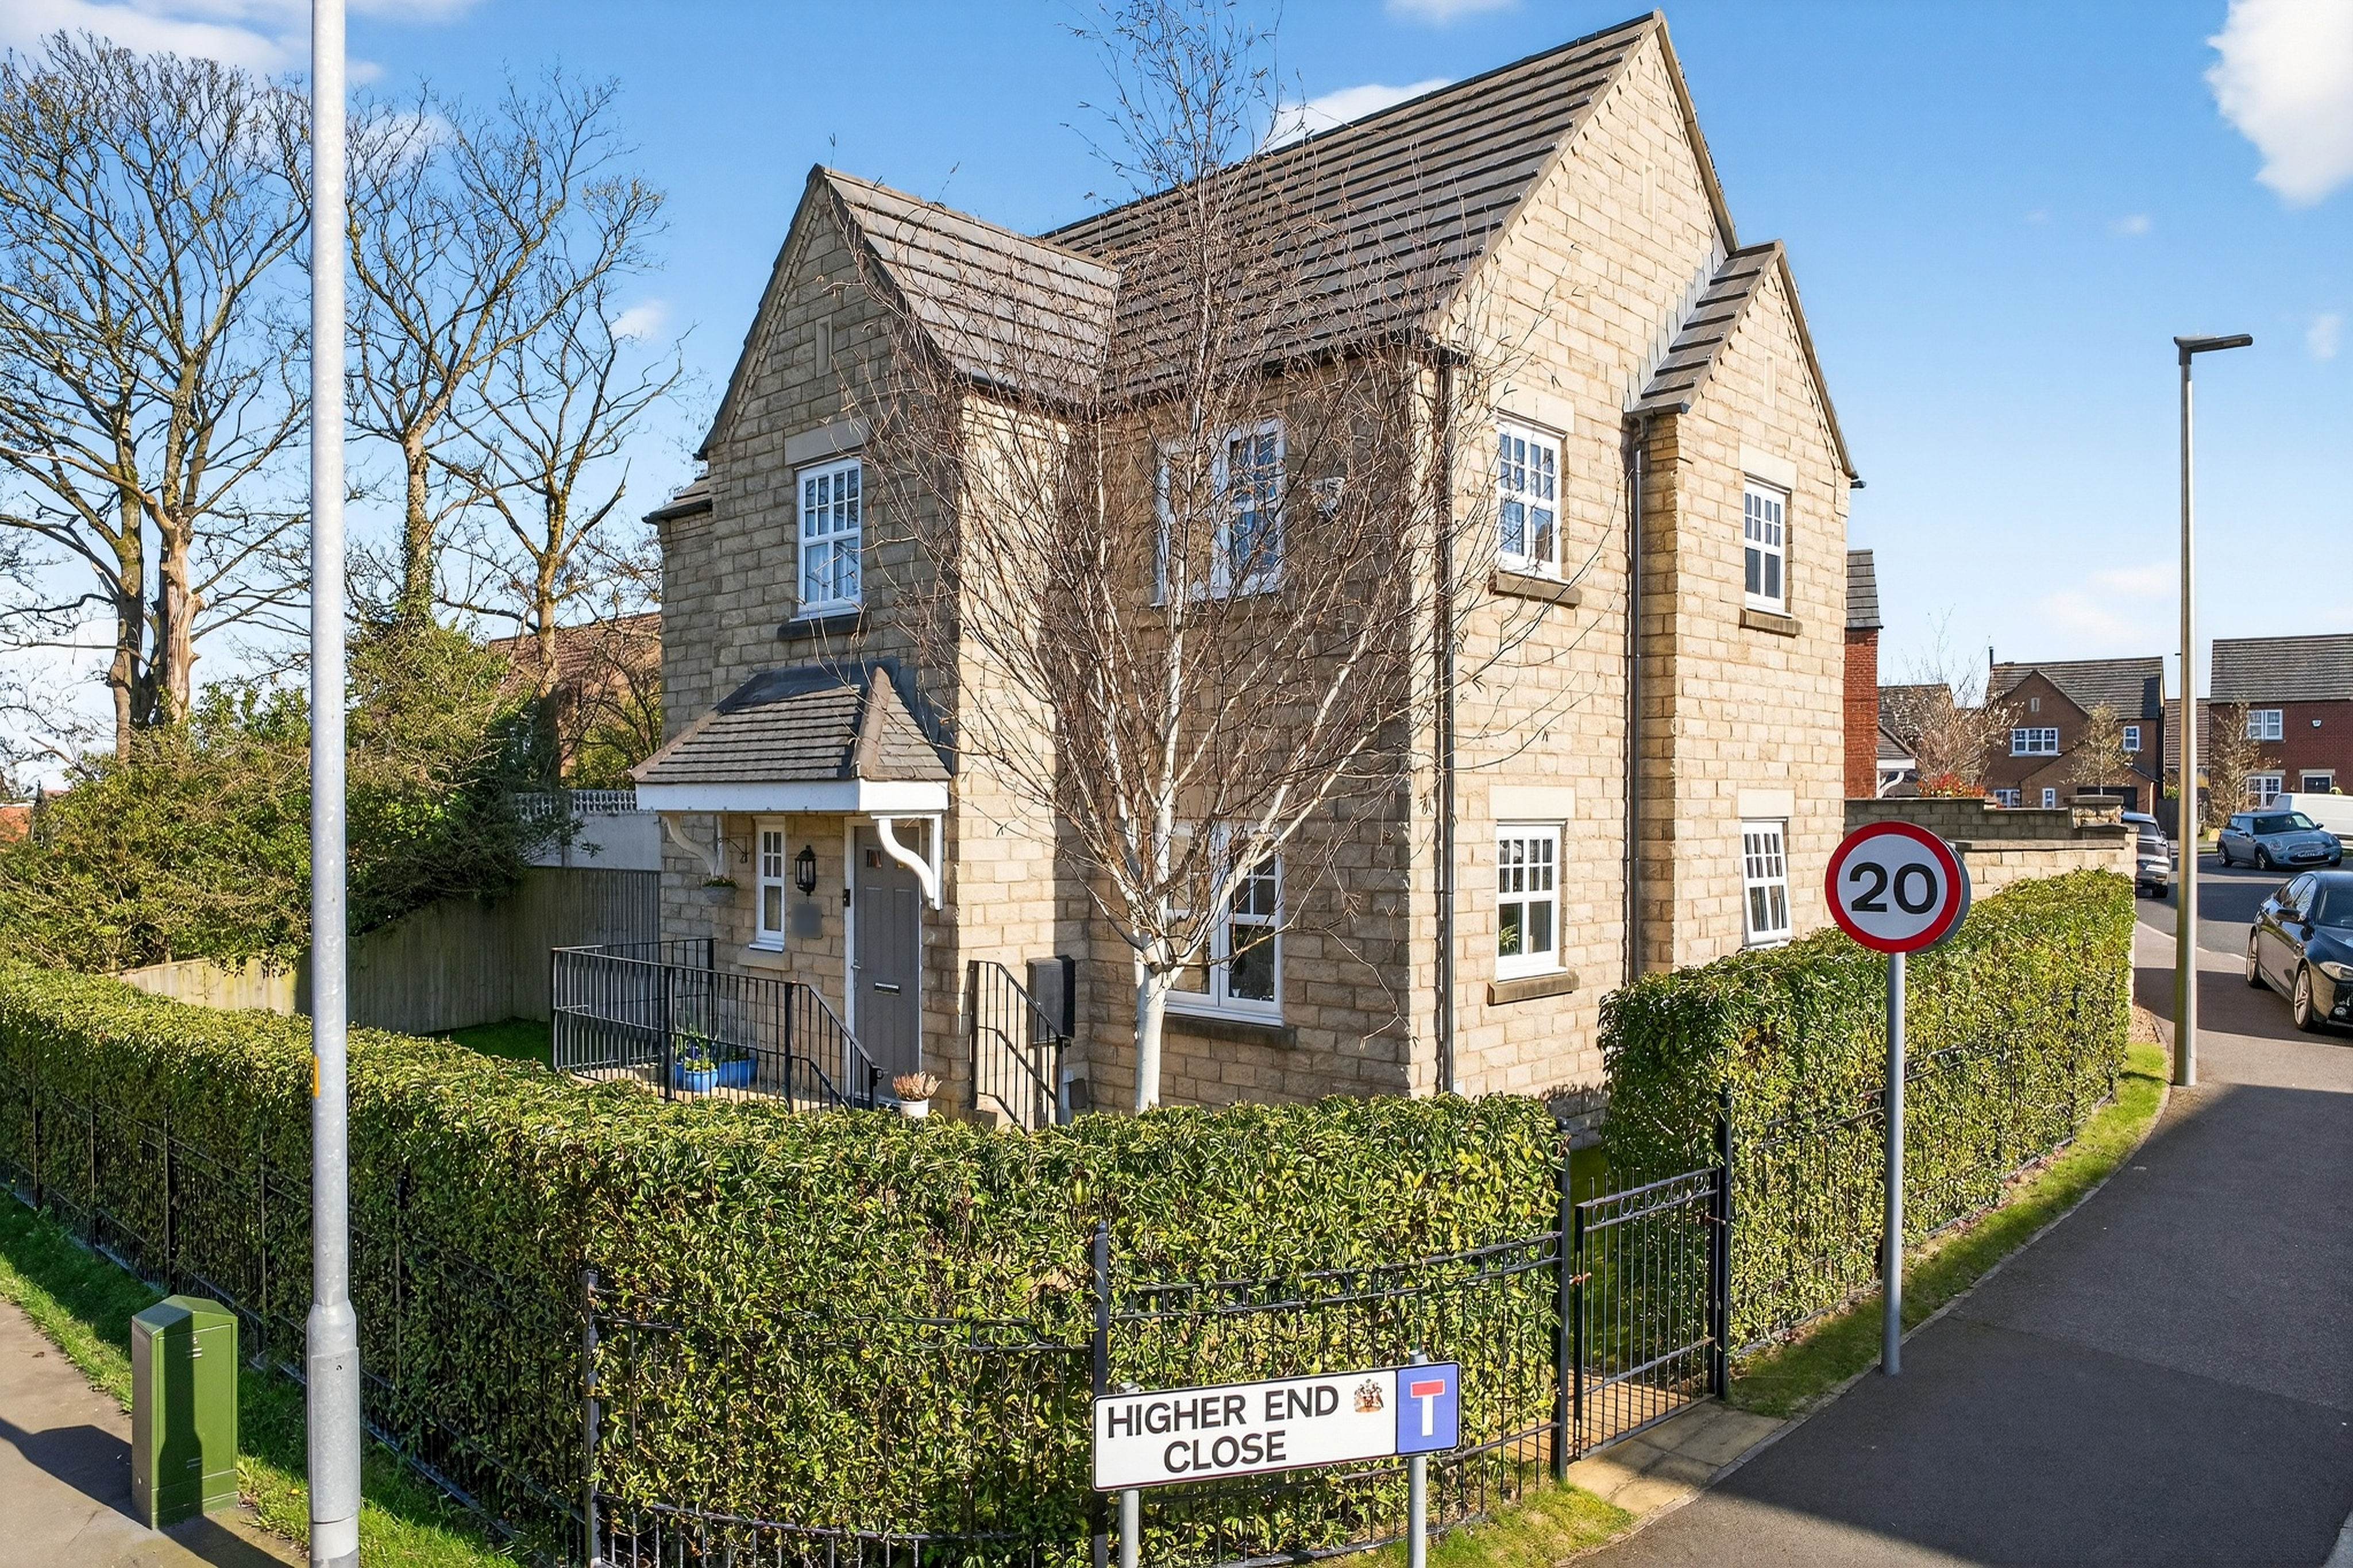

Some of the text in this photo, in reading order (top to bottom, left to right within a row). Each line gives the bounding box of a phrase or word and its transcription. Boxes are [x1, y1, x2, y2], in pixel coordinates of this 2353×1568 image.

[1849, 862, 1938, 915] 20
[1108, 1385, 1339, 1438] HIGHER END
[1164, 1430, 1286, 1473] CLOSE
